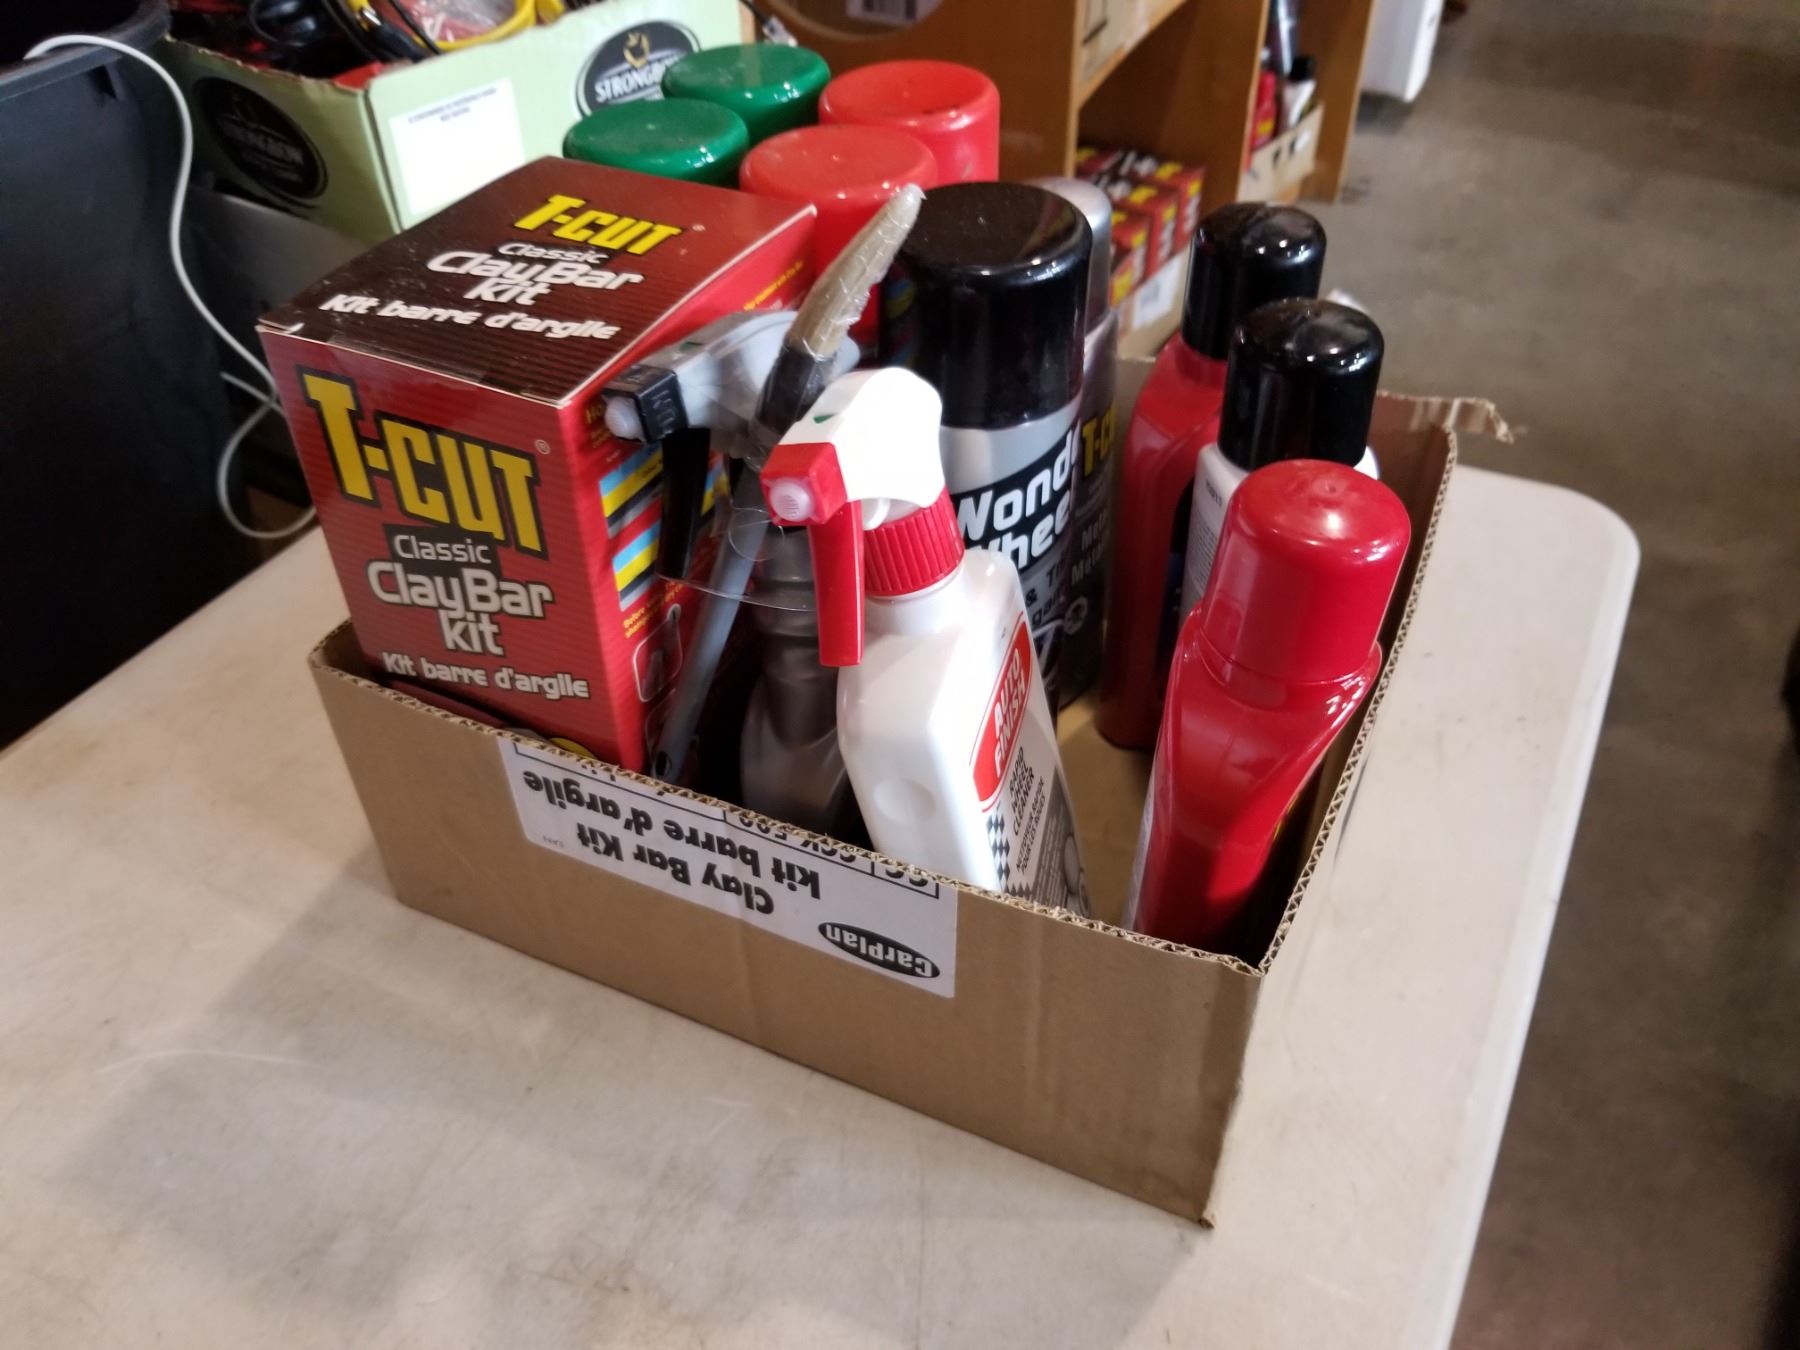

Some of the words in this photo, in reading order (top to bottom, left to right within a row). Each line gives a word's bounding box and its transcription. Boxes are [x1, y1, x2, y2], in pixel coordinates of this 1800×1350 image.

[514, 193, 683, 256] T-CUT
[498, 241, 609, 264] Classic
[319, 293, 380, 315] Kit
[376, 300, 482, 326] barre
[484, 312, 622, 340] d'argile
[301, 371, 543, 554] T-CUT
[393, 533, 493, 565] Classic
[382, 651, 418, 677] Kit
[421, 657, 489, 687] barre
[494, 667, 589, 701] d'argile
[994, 647, 1020, 740] AUTO
[994, 667, 1026, 779] FINISH
[1009, 746, 1024, 797] RAPID
[1012, 762, 1028, 814] WHEEL
[522, 769, 653, 837] d'argile
[1013, 766, 1035, 837] CLEANER
[576, 821, 625, 863] Kit
[632, 843, 692, 887] Bar
[662, 818, 762, 879] barre
[702, 861, 775, 915] Clay
[770, 856, 822, 900] kit
